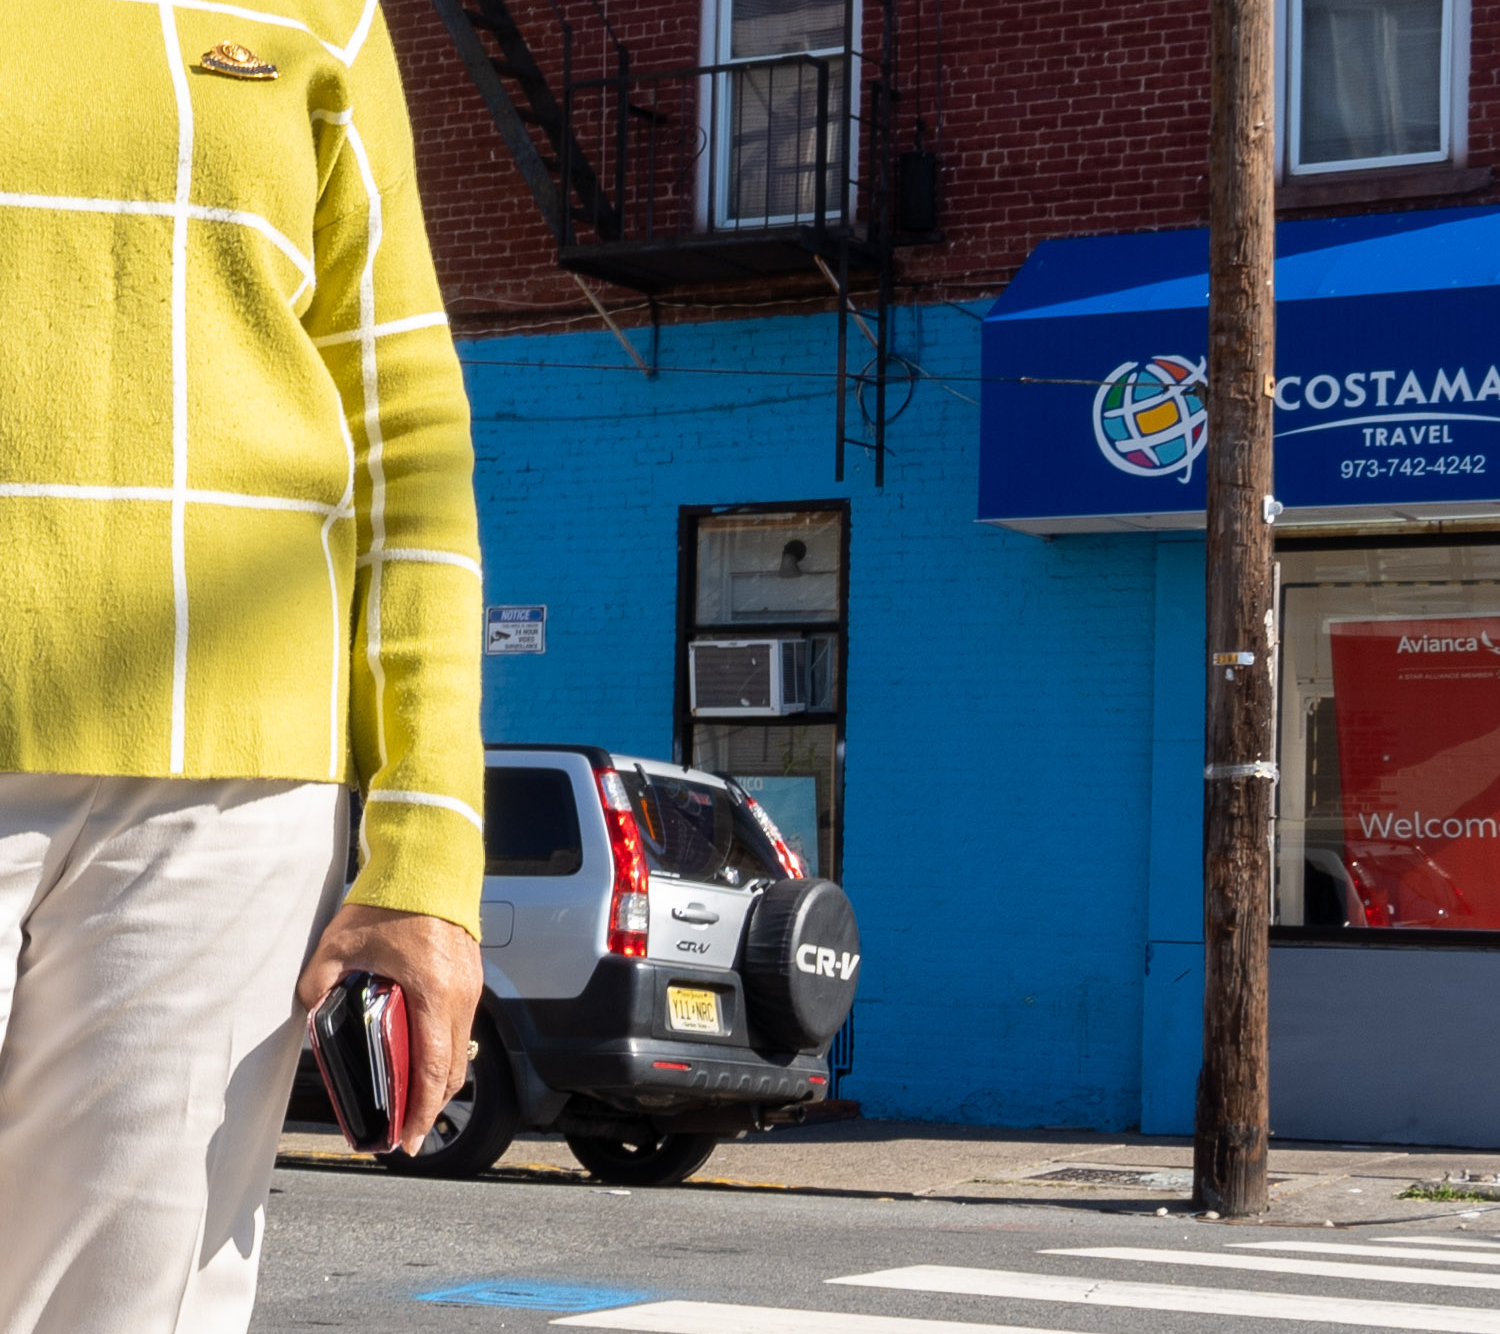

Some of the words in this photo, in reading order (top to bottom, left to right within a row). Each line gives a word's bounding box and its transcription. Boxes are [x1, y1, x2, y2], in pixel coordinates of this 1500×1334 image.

[1362, 425, 1453, 447] TRAVEL
[1340, 454, 1486, 478] 973-742-4242
[501, 609, 530, 621] NOTICE
[1397, 634, 1479, 654] Avianca
[1425, 672, 1460, 680] ALLIANCE
[1460, 671, 1494, 679] MEMBER
